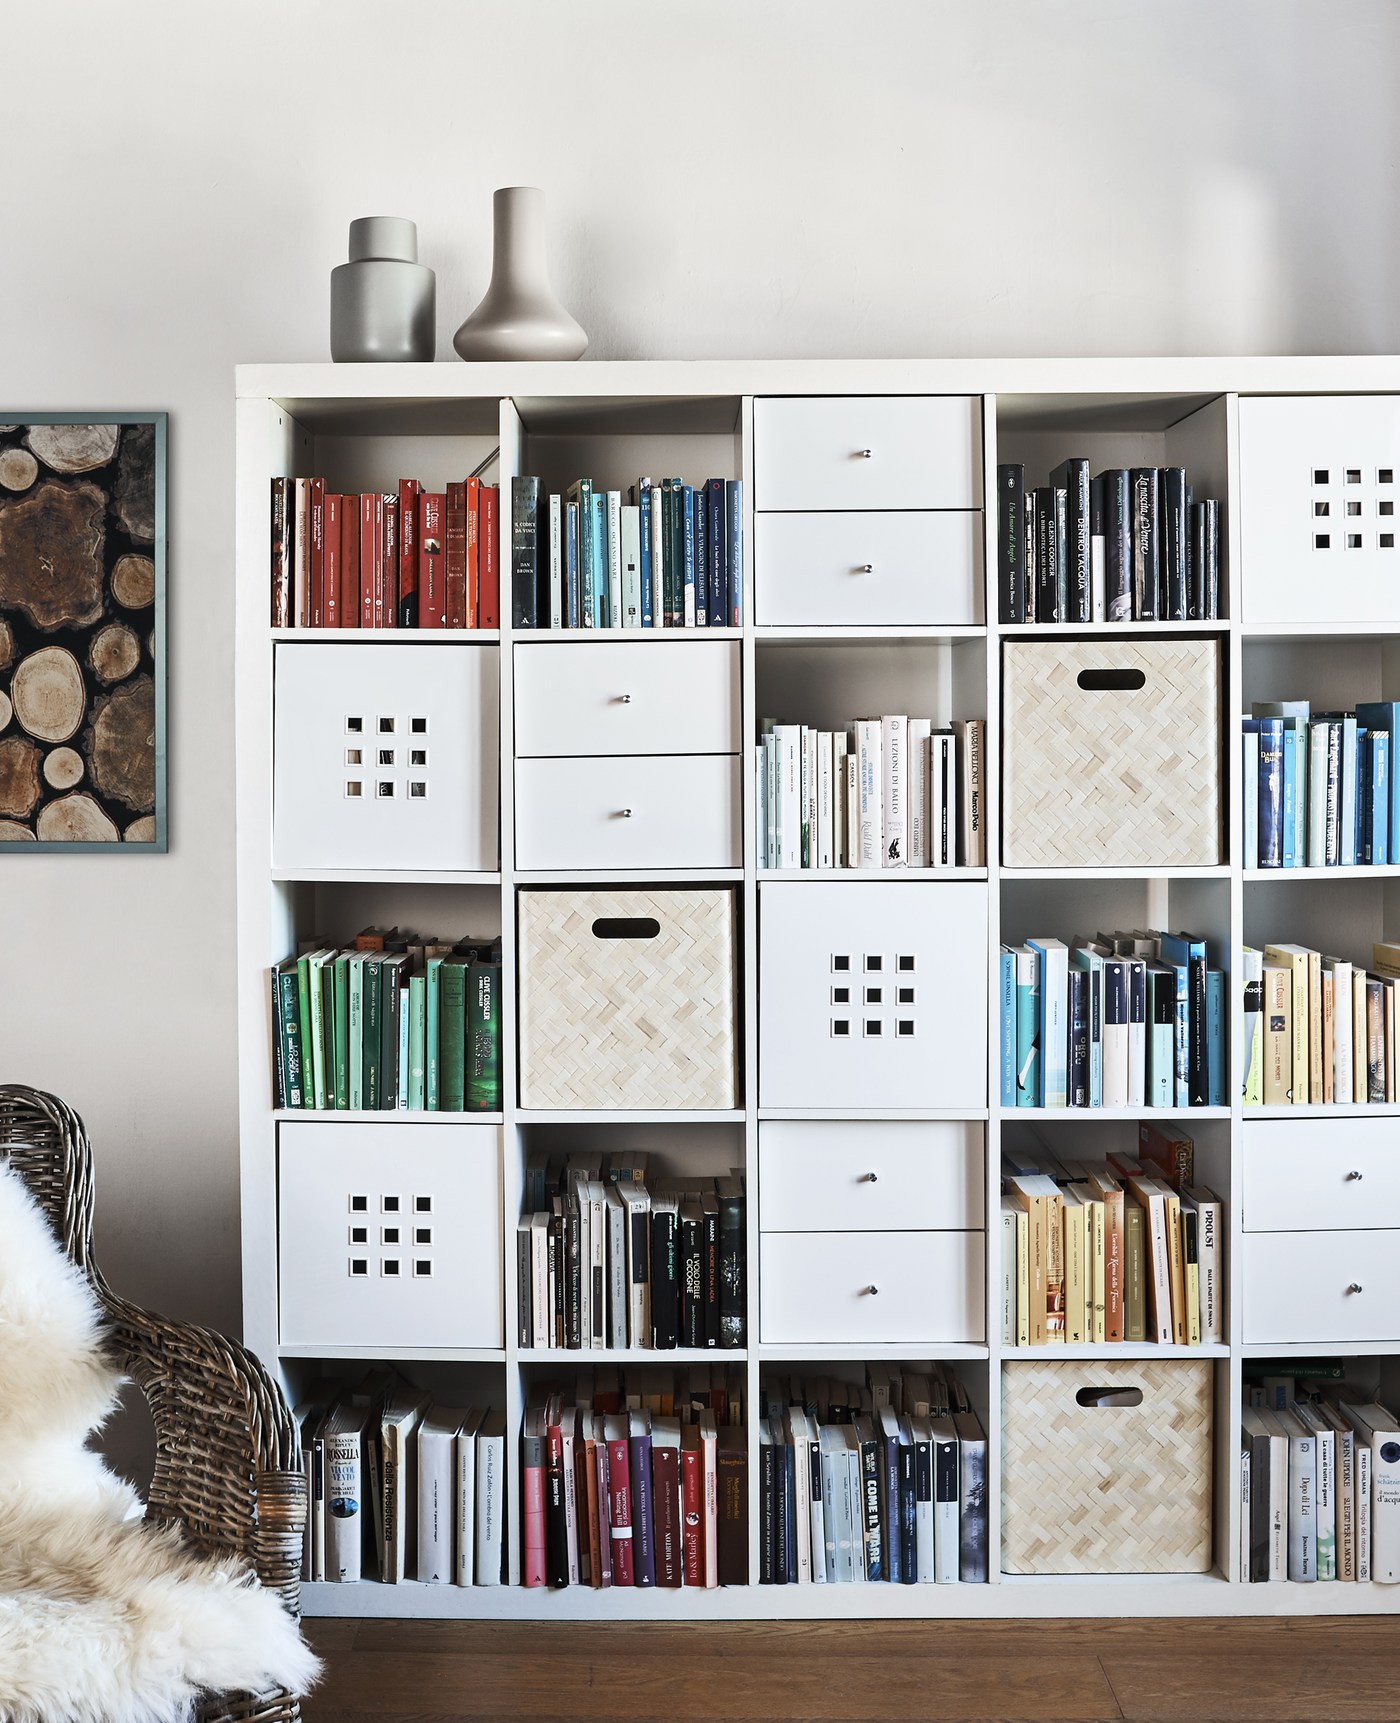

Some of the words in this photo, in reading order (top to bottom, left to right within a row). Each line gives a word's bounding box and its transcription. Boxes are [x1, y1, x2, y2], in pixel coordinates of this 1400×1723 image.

[892, 776, 898, 784] DI
[1205, 1210, 1214, 1248] PROUST
[1107, 1257, 1118, 1274] Karma
[385, 1462, 394, 1485] dalla
[1300, 1477, 1309, 1493] Dopo
[867, 1480, 878, 1513] COME
[385, 1487, 394, 1541] Resistenza
[869, 1515, 879, 1525] IL
[686, 1532, 697, 1559] Marley
[870, 1528, 880, 1564] MARE
[1343, 1538, 1350, 1546] IL
